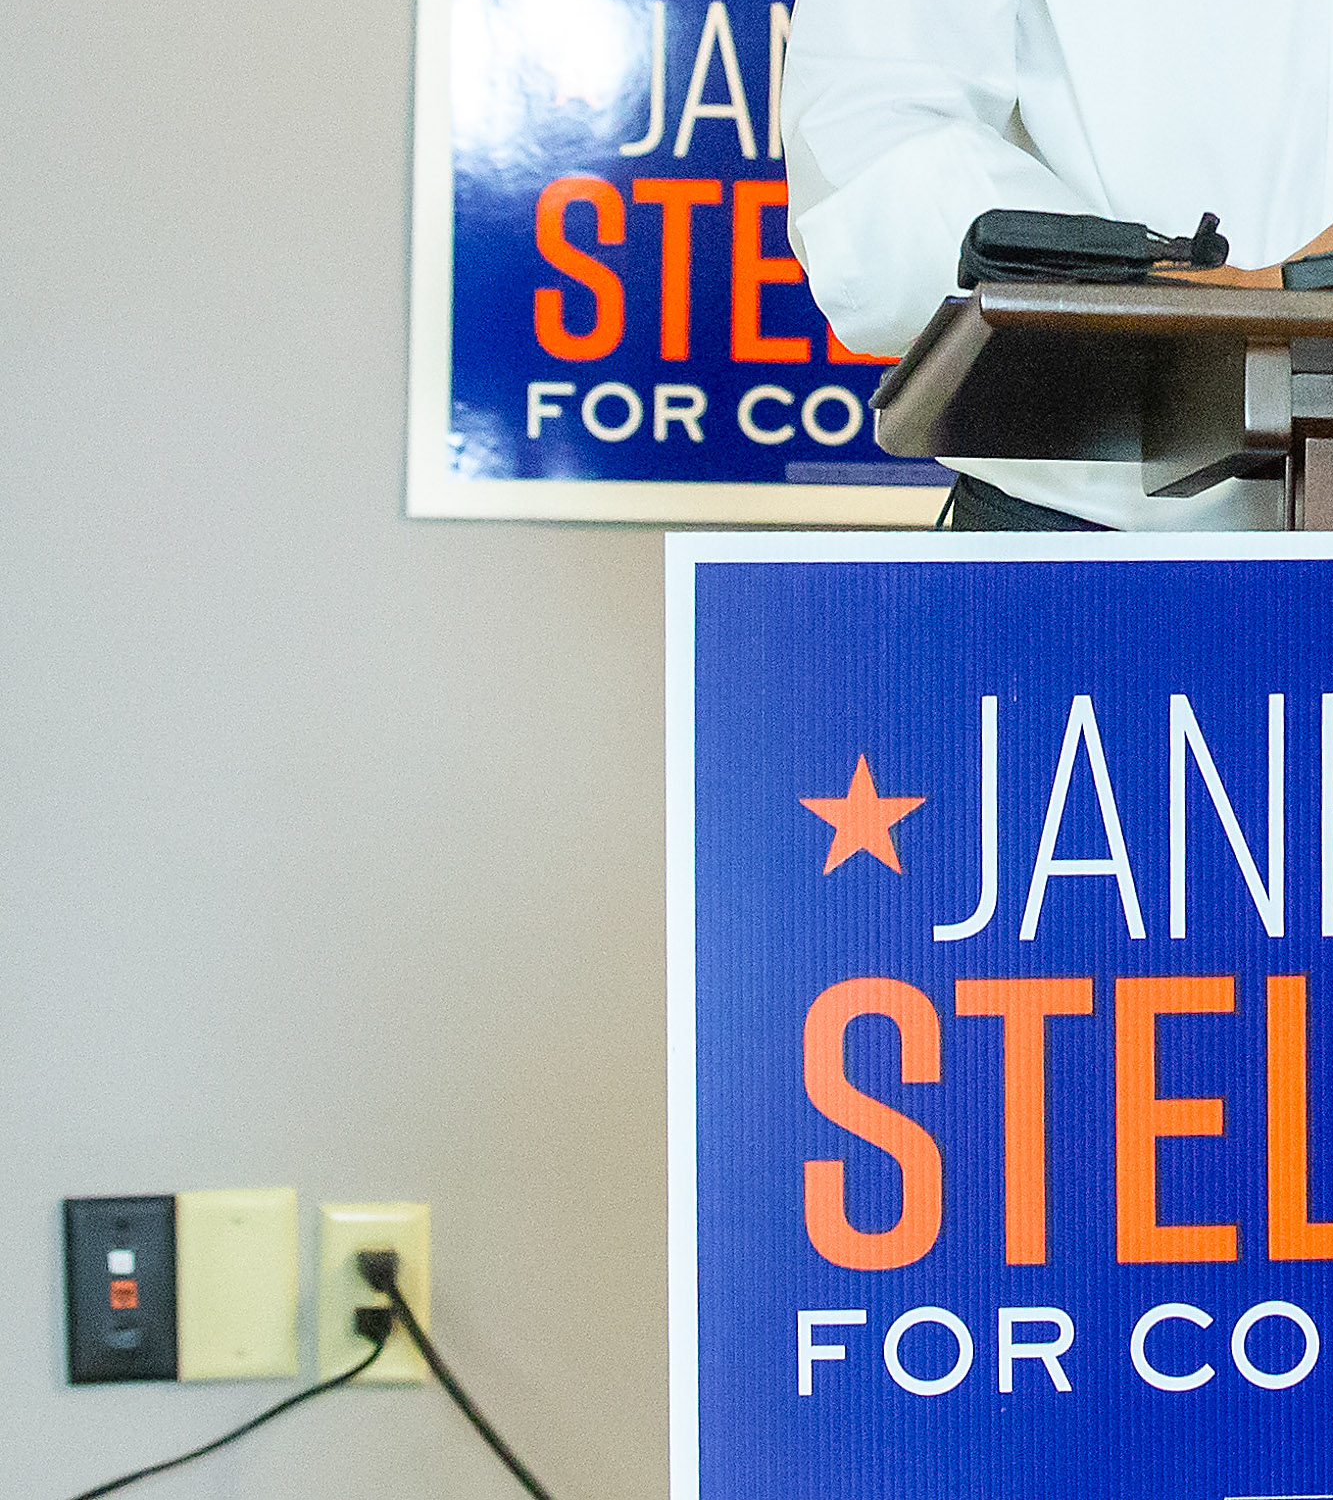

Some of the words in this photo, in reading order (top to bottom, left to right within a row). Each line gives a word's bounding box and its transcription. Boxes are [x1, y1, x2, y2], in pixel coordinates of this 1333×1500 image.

[534, 174, 902, 365] STE
[526, 381, 709, 443] FOR
[797, 1306, 1074, 1396] FOR
